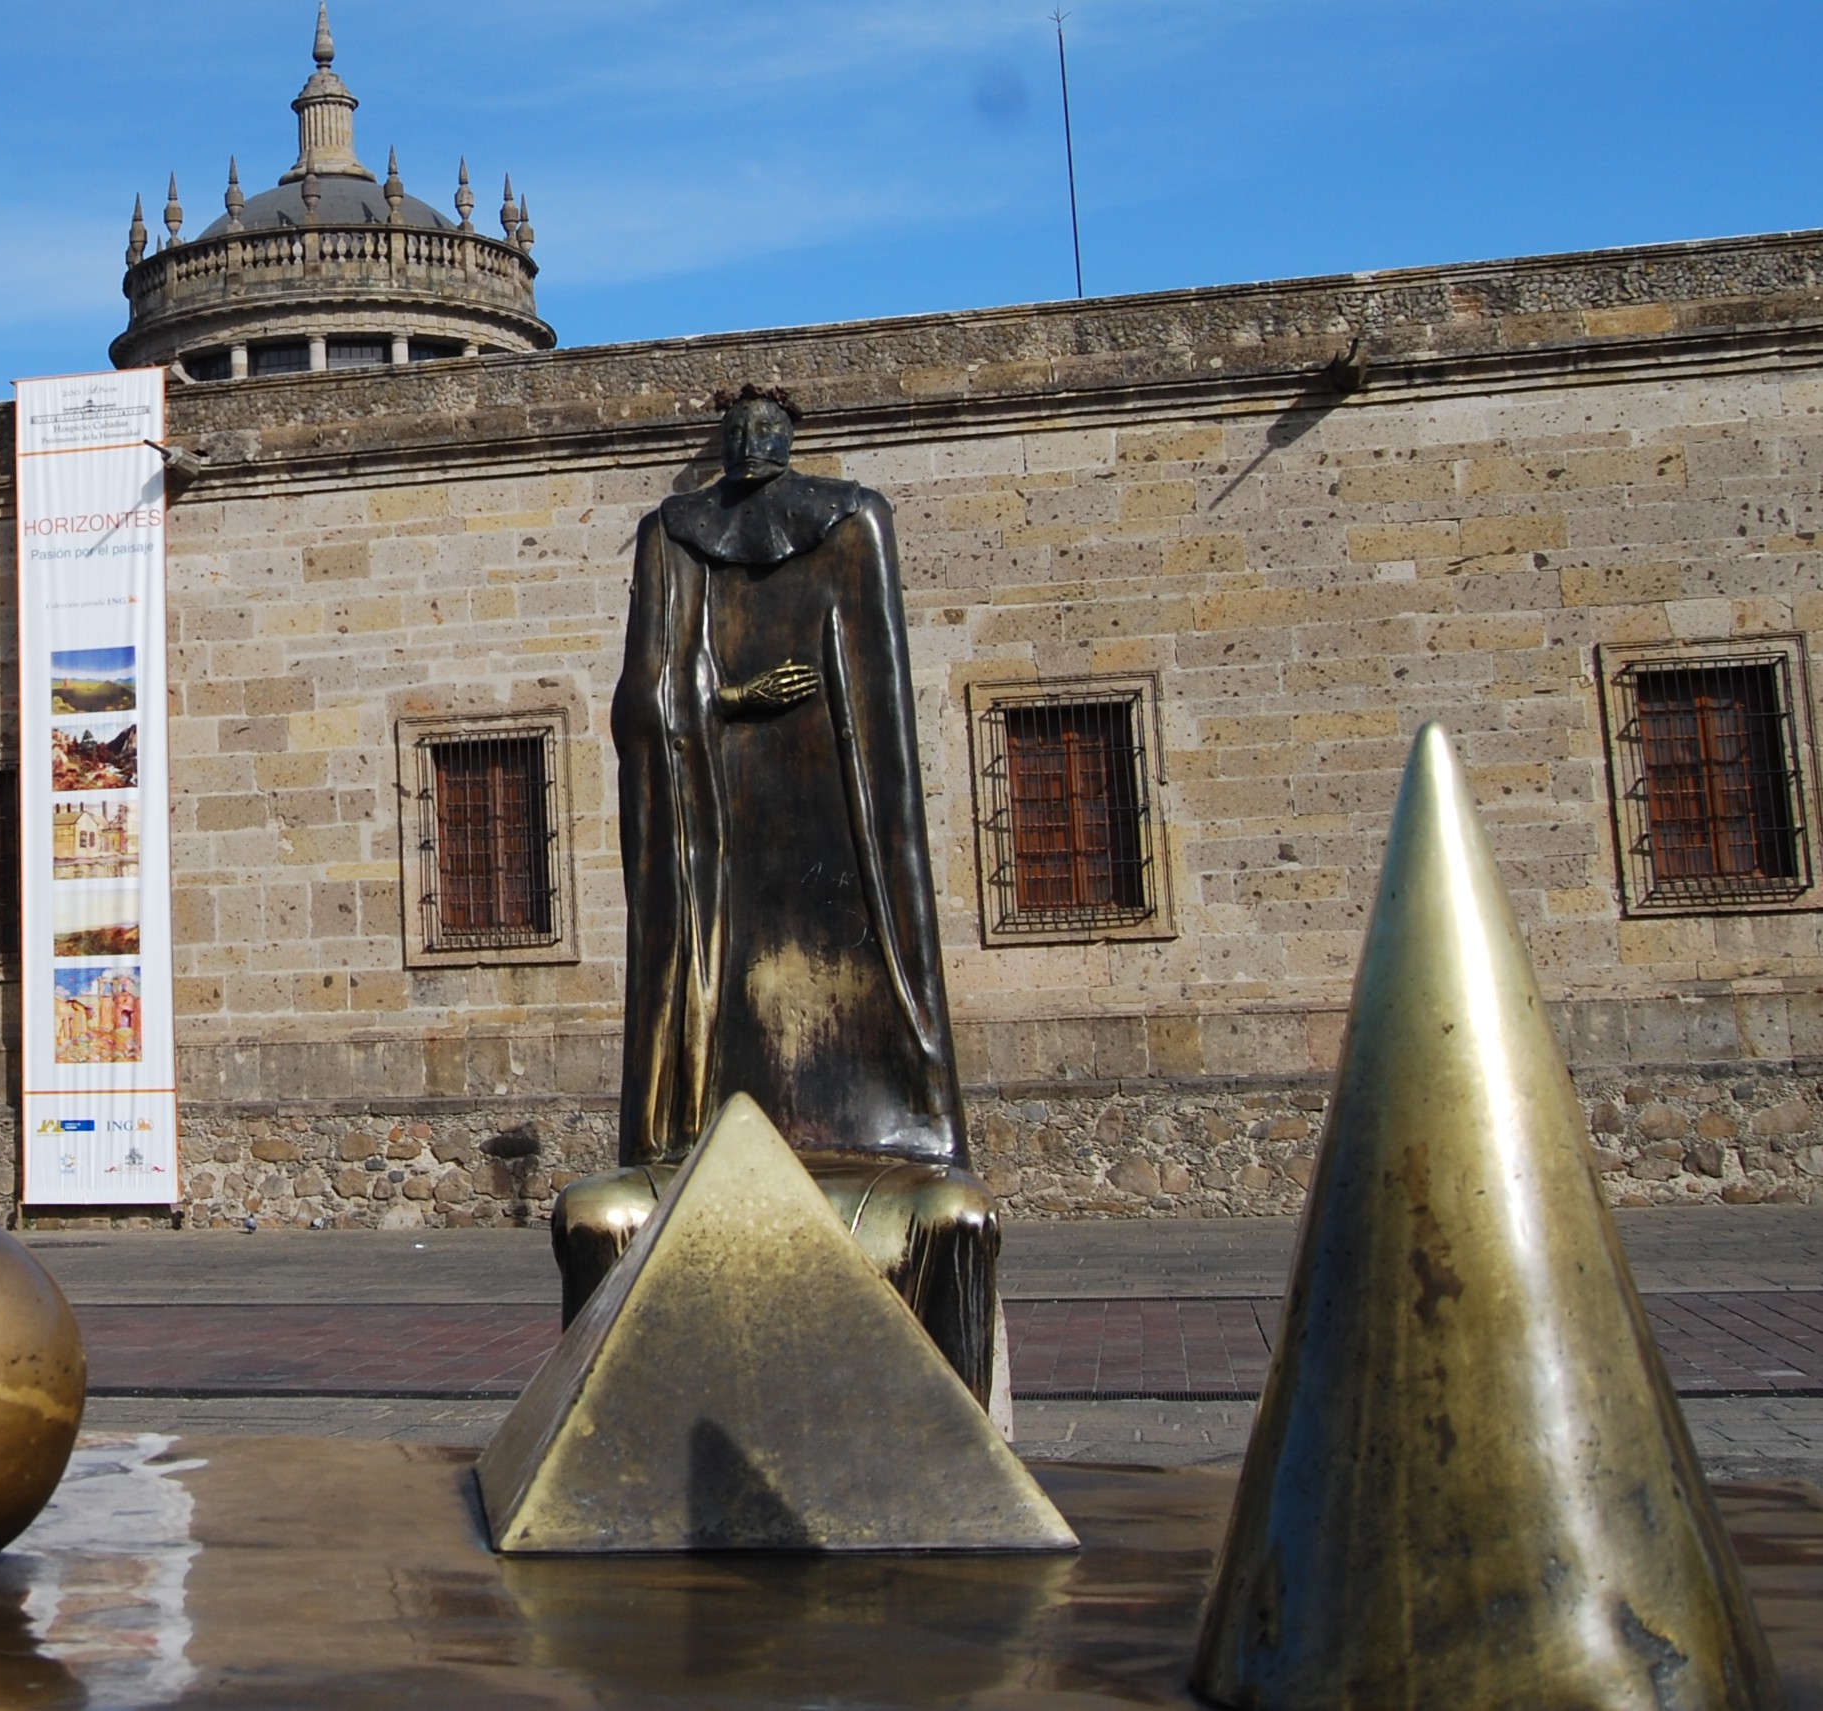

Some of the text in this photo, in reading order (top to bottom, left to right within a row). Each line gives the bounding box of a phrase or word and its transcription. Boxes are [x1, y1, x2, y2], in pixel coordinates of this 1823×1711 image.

[53, 420, 129, 434] Hospicio Cabañas
[82, 433, 91, 441] de
[91, 432, 99, 440] la
[24, 509, 162, 537] HORIZONTES
[31, 541, 154, 560] Pasión por el paisaje
[107, 597, 127, 606] ING
[106, 1120, 134, 1132] ING
